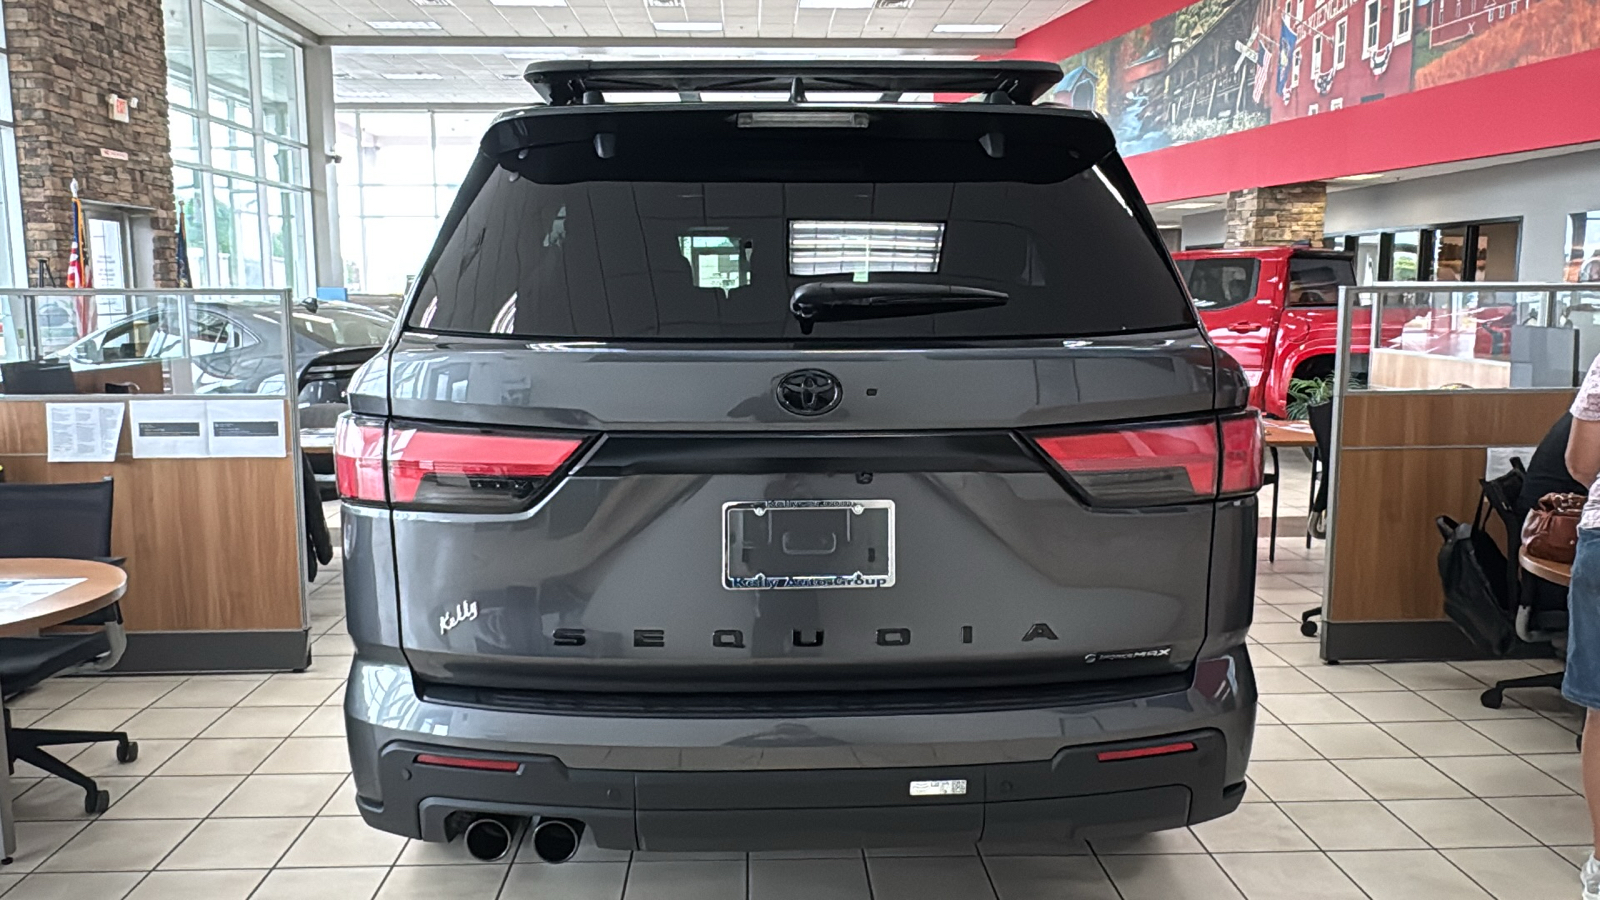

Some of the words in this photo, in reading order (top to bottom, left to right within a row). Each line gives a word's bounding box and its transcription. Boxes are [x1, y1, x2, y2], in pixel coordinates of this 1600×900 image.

[732, 577, 778, 589] Kelly
[439, 599, 478, 636] Kelly
[552, 622, 1059, 649] SEQUOIA
